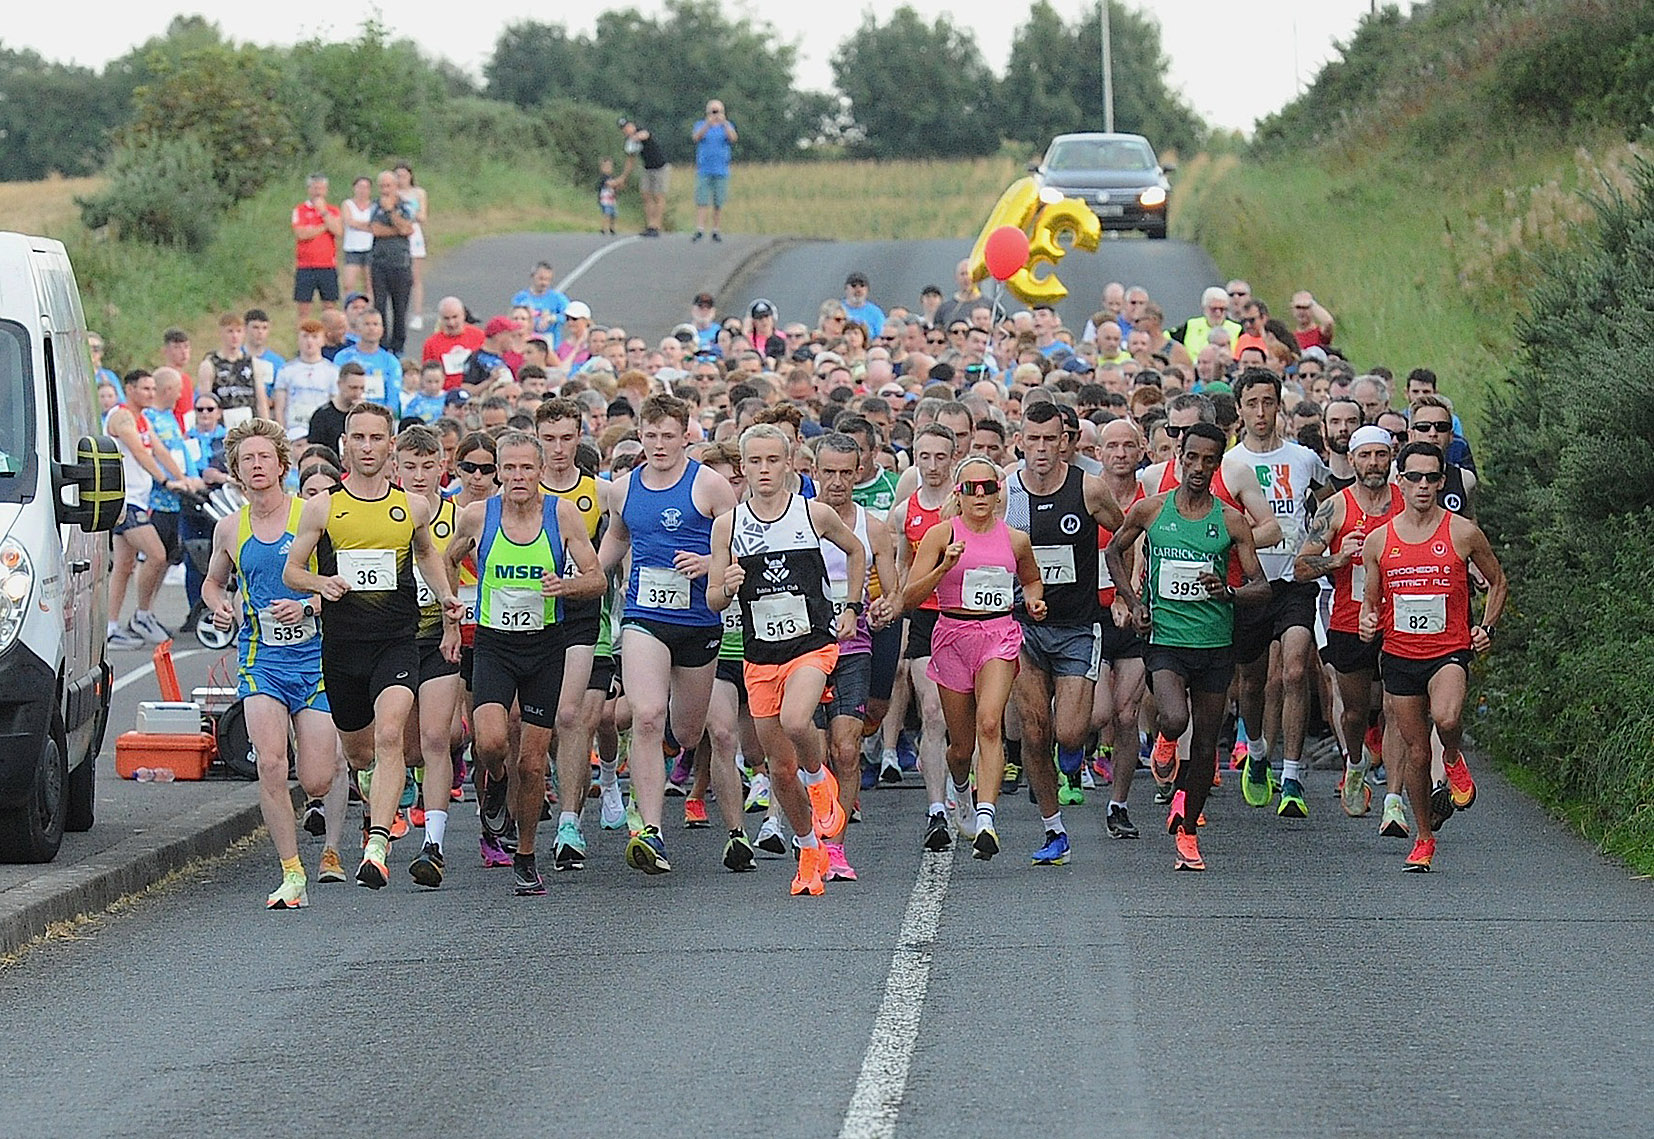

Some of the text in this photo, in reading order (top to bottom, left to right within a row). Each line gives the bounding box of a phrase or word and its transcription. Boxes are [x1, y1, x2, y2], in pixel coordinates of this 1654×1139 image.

[1153, 546, 1196, 560] CARRICK
[356, 569, 378, 585] 36
[494, 564, 544, 579] MSB
[1170, 581, 1200, 596] 395
[649, 589, 678, 604] 337
[974, 592, 1002, 606] 506
[501, 612, 531, 626] 512
[1409, 615, 1428, 630] 82
[273, 625, 304, 641] 535
[766, 619, 796, 636] 513
